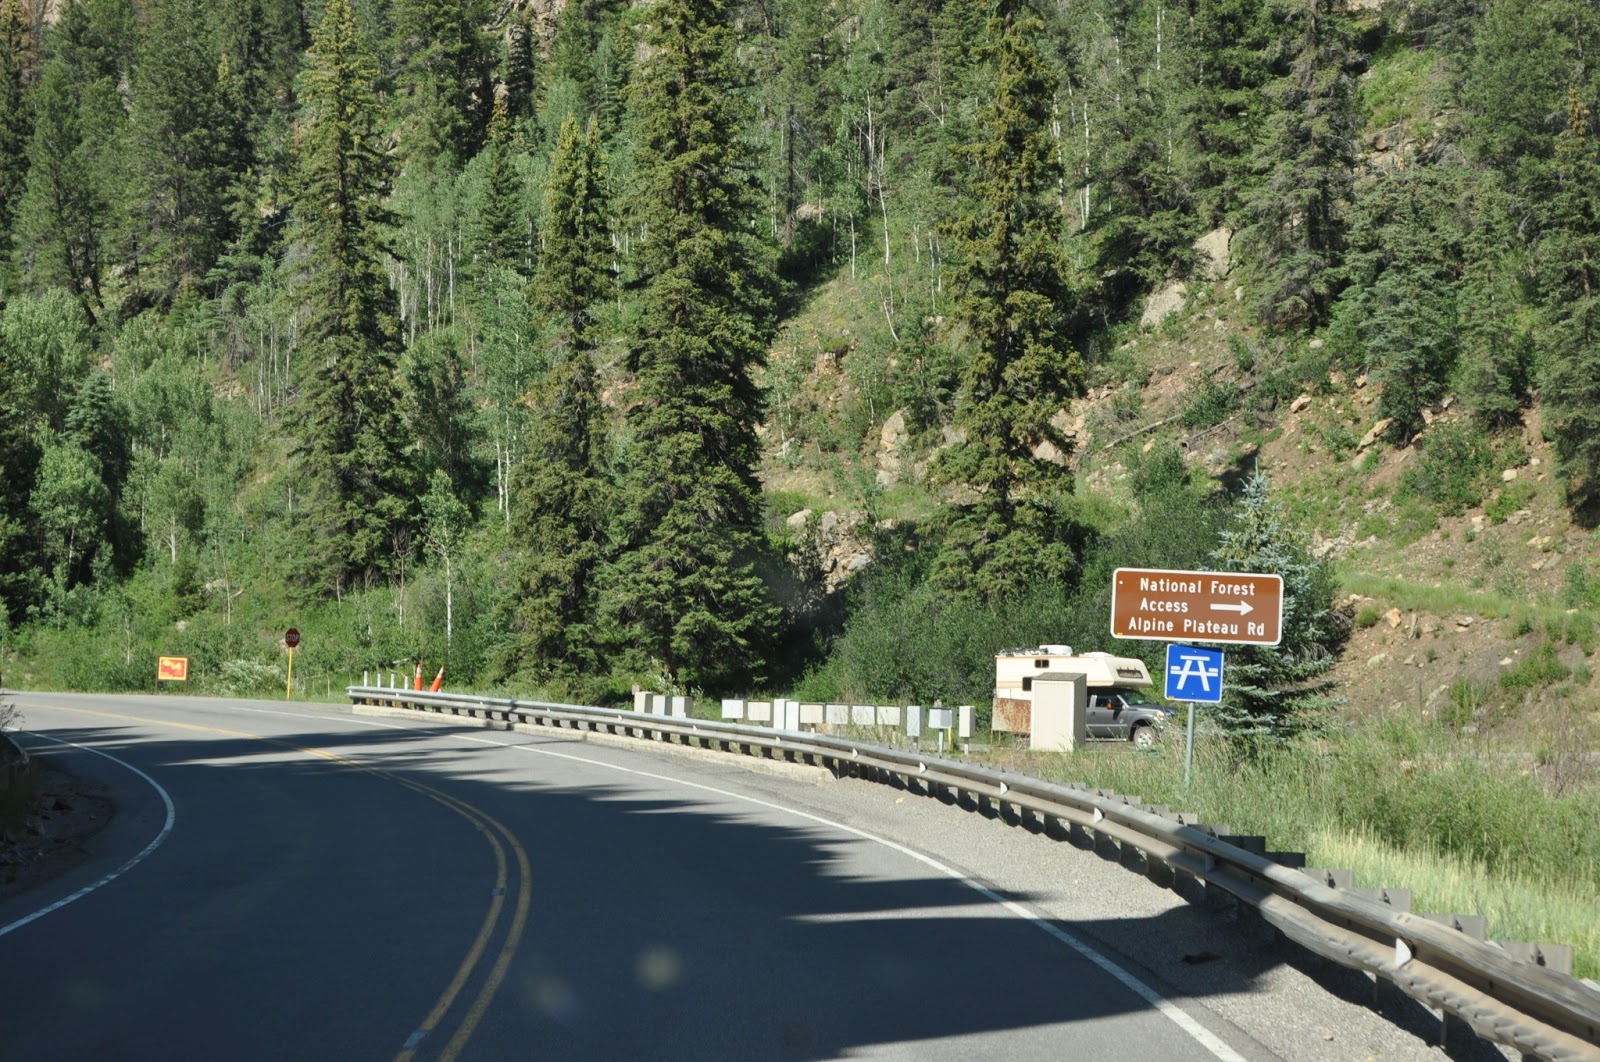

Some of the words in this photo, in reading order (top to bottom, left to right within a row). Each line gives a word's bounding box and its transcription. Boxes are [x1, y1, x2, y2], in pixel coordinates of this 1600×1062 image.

[1140, 577, 1202, 594] National
[1211, 580, 1255, 596] Forest
[1140, 597, 1188, 612] Access
[1128, 616, 1174, 633] Alpine
[1184, 619, 1238, 635] Plateau
[1248, 622, 1265, 636] Rd
[286, 633, 300, 642] STOP
